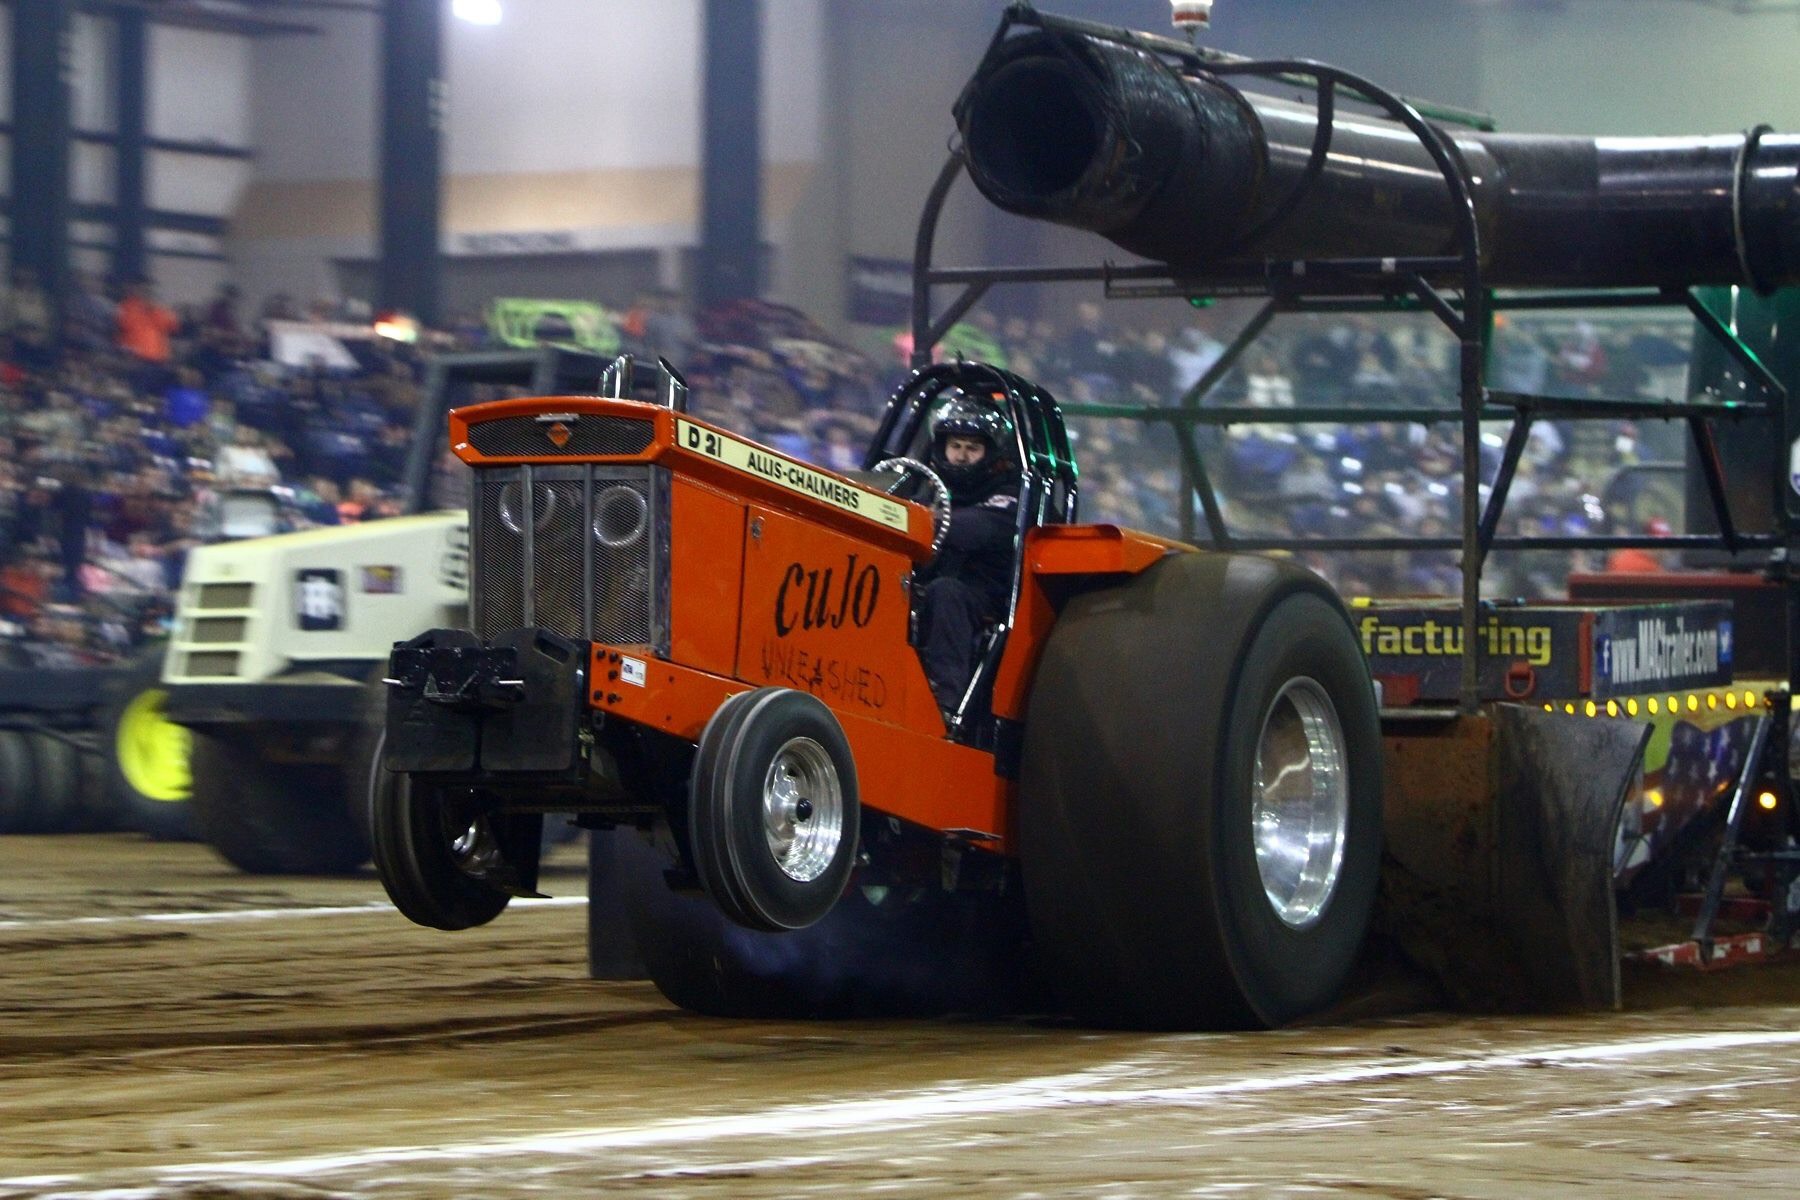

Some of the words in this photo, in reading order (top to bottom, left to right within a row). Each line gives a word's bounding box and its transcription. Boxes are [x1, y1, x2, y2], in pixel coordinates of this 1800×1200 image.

[688, 425, 701, 449] D
[705, 433, 722, 458] 21
[747, 451, 860, 509] ALLIS-CHALMERS
[761, 638, 887, 709] UNLEASHED
